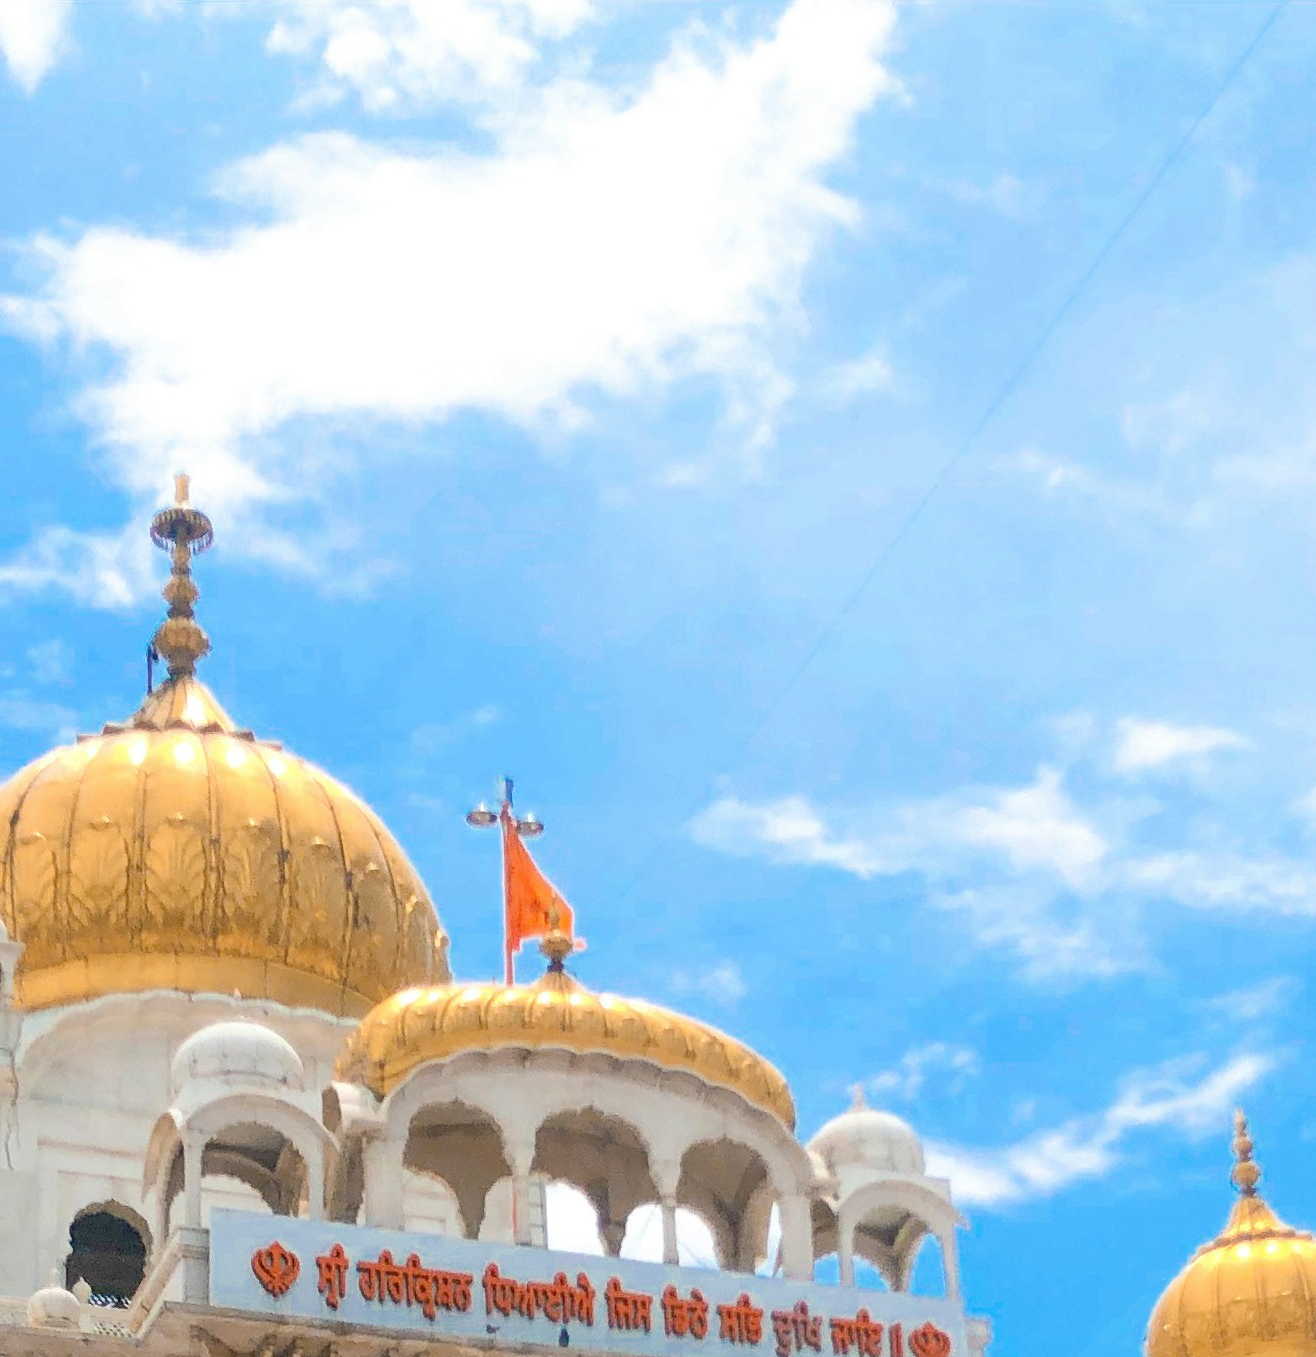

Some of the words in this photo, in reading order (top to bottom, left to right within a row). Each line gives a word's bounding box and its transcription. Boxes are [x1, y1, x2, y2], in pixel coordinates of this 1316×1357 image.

[604, 1275, 654, 1335] ਜਿਸ
[661, 1284, 710, 1340] ਡਿਠੇ
[717, 1291, 765, 1346] ਸਭਿ
